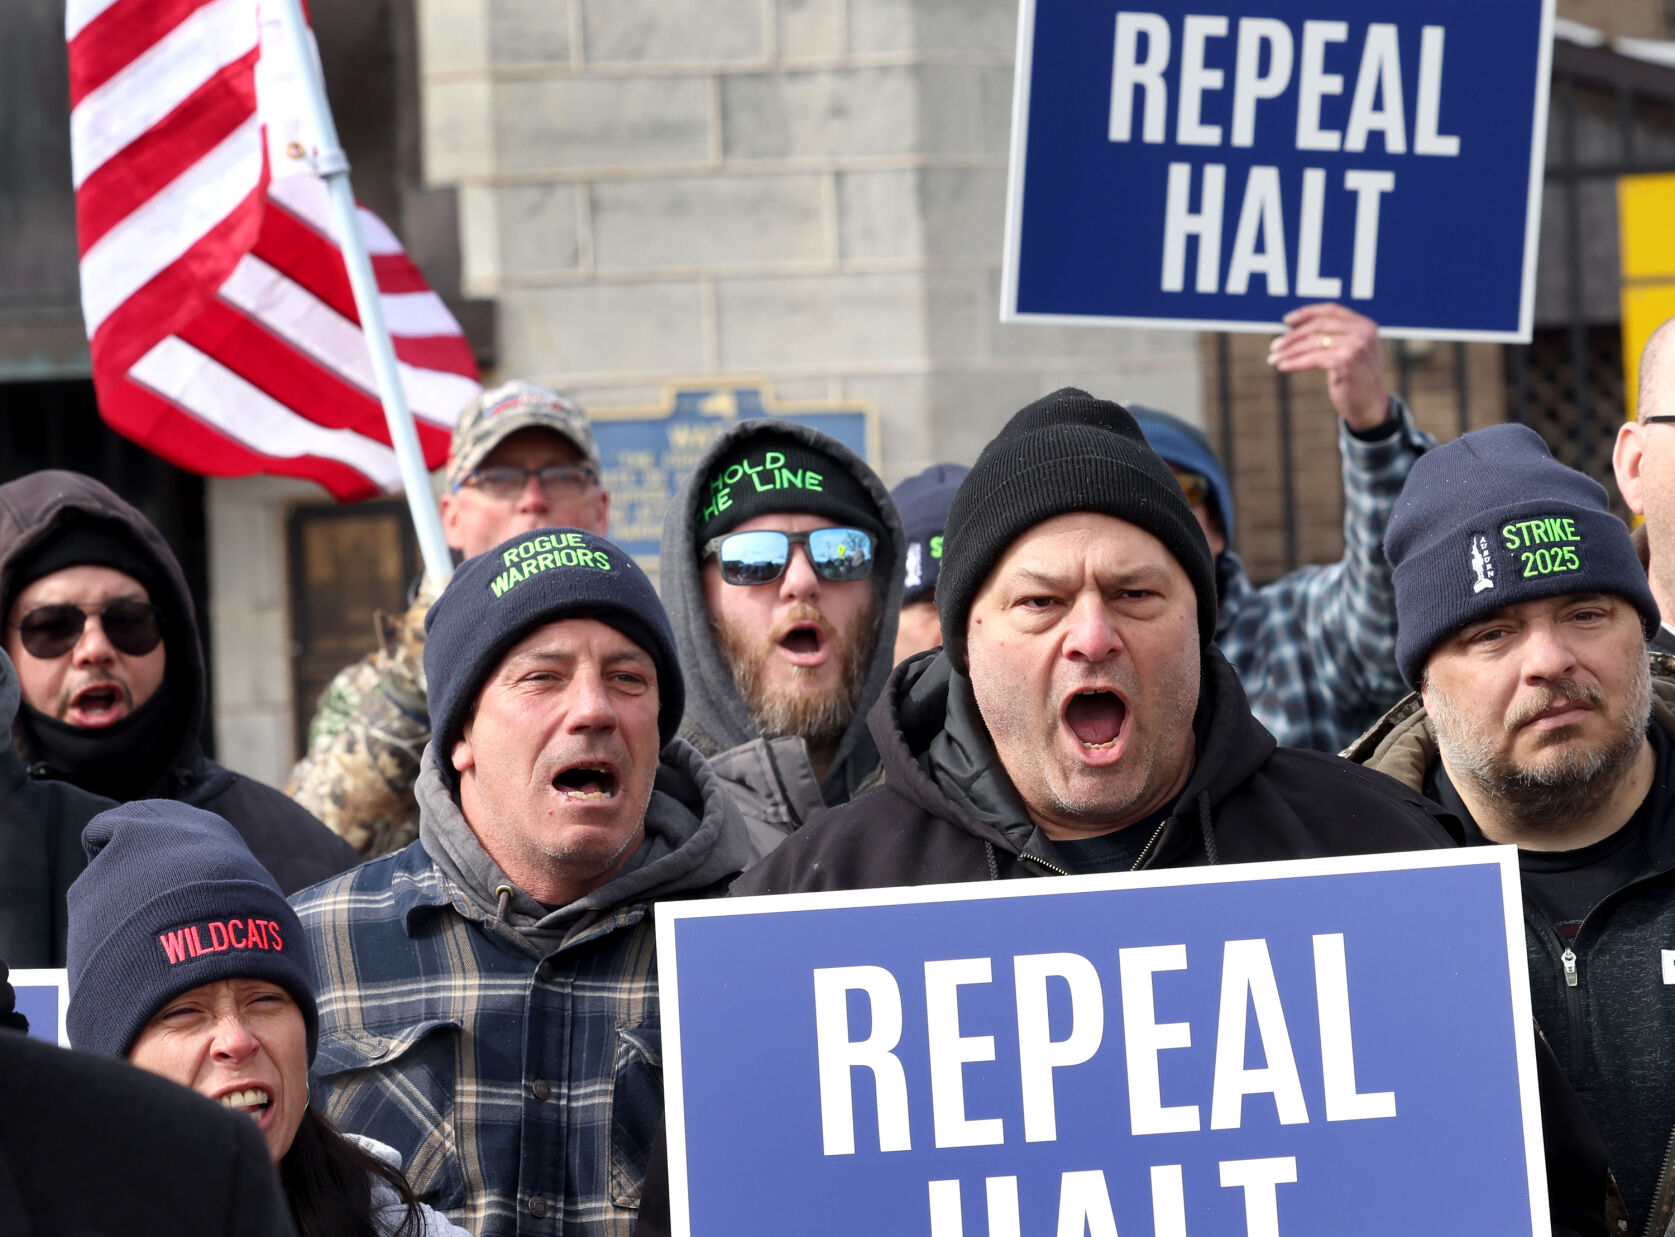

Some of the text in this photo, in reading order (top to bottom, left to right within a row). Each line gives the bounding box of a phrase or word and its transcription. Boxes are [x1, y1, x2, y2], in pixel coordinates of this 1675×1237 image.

[1108, 11, 1461, 157] REPEAL
[1161, 162, 1396, 300] HALT
[709, 451, 786, 493] HOLD
[750, 467, 824, 493] LINE
[502, 533, 587, 568] ROGUE
[1502, 518, 1581, 550] STRIKE
[490, 548, 612, 599] WARRIORS
[1520, 546, 1581, 579] 2025
[159, 918, 284, 966] WILDCATS
[813, 932, 1398, 1157] REPEAL
